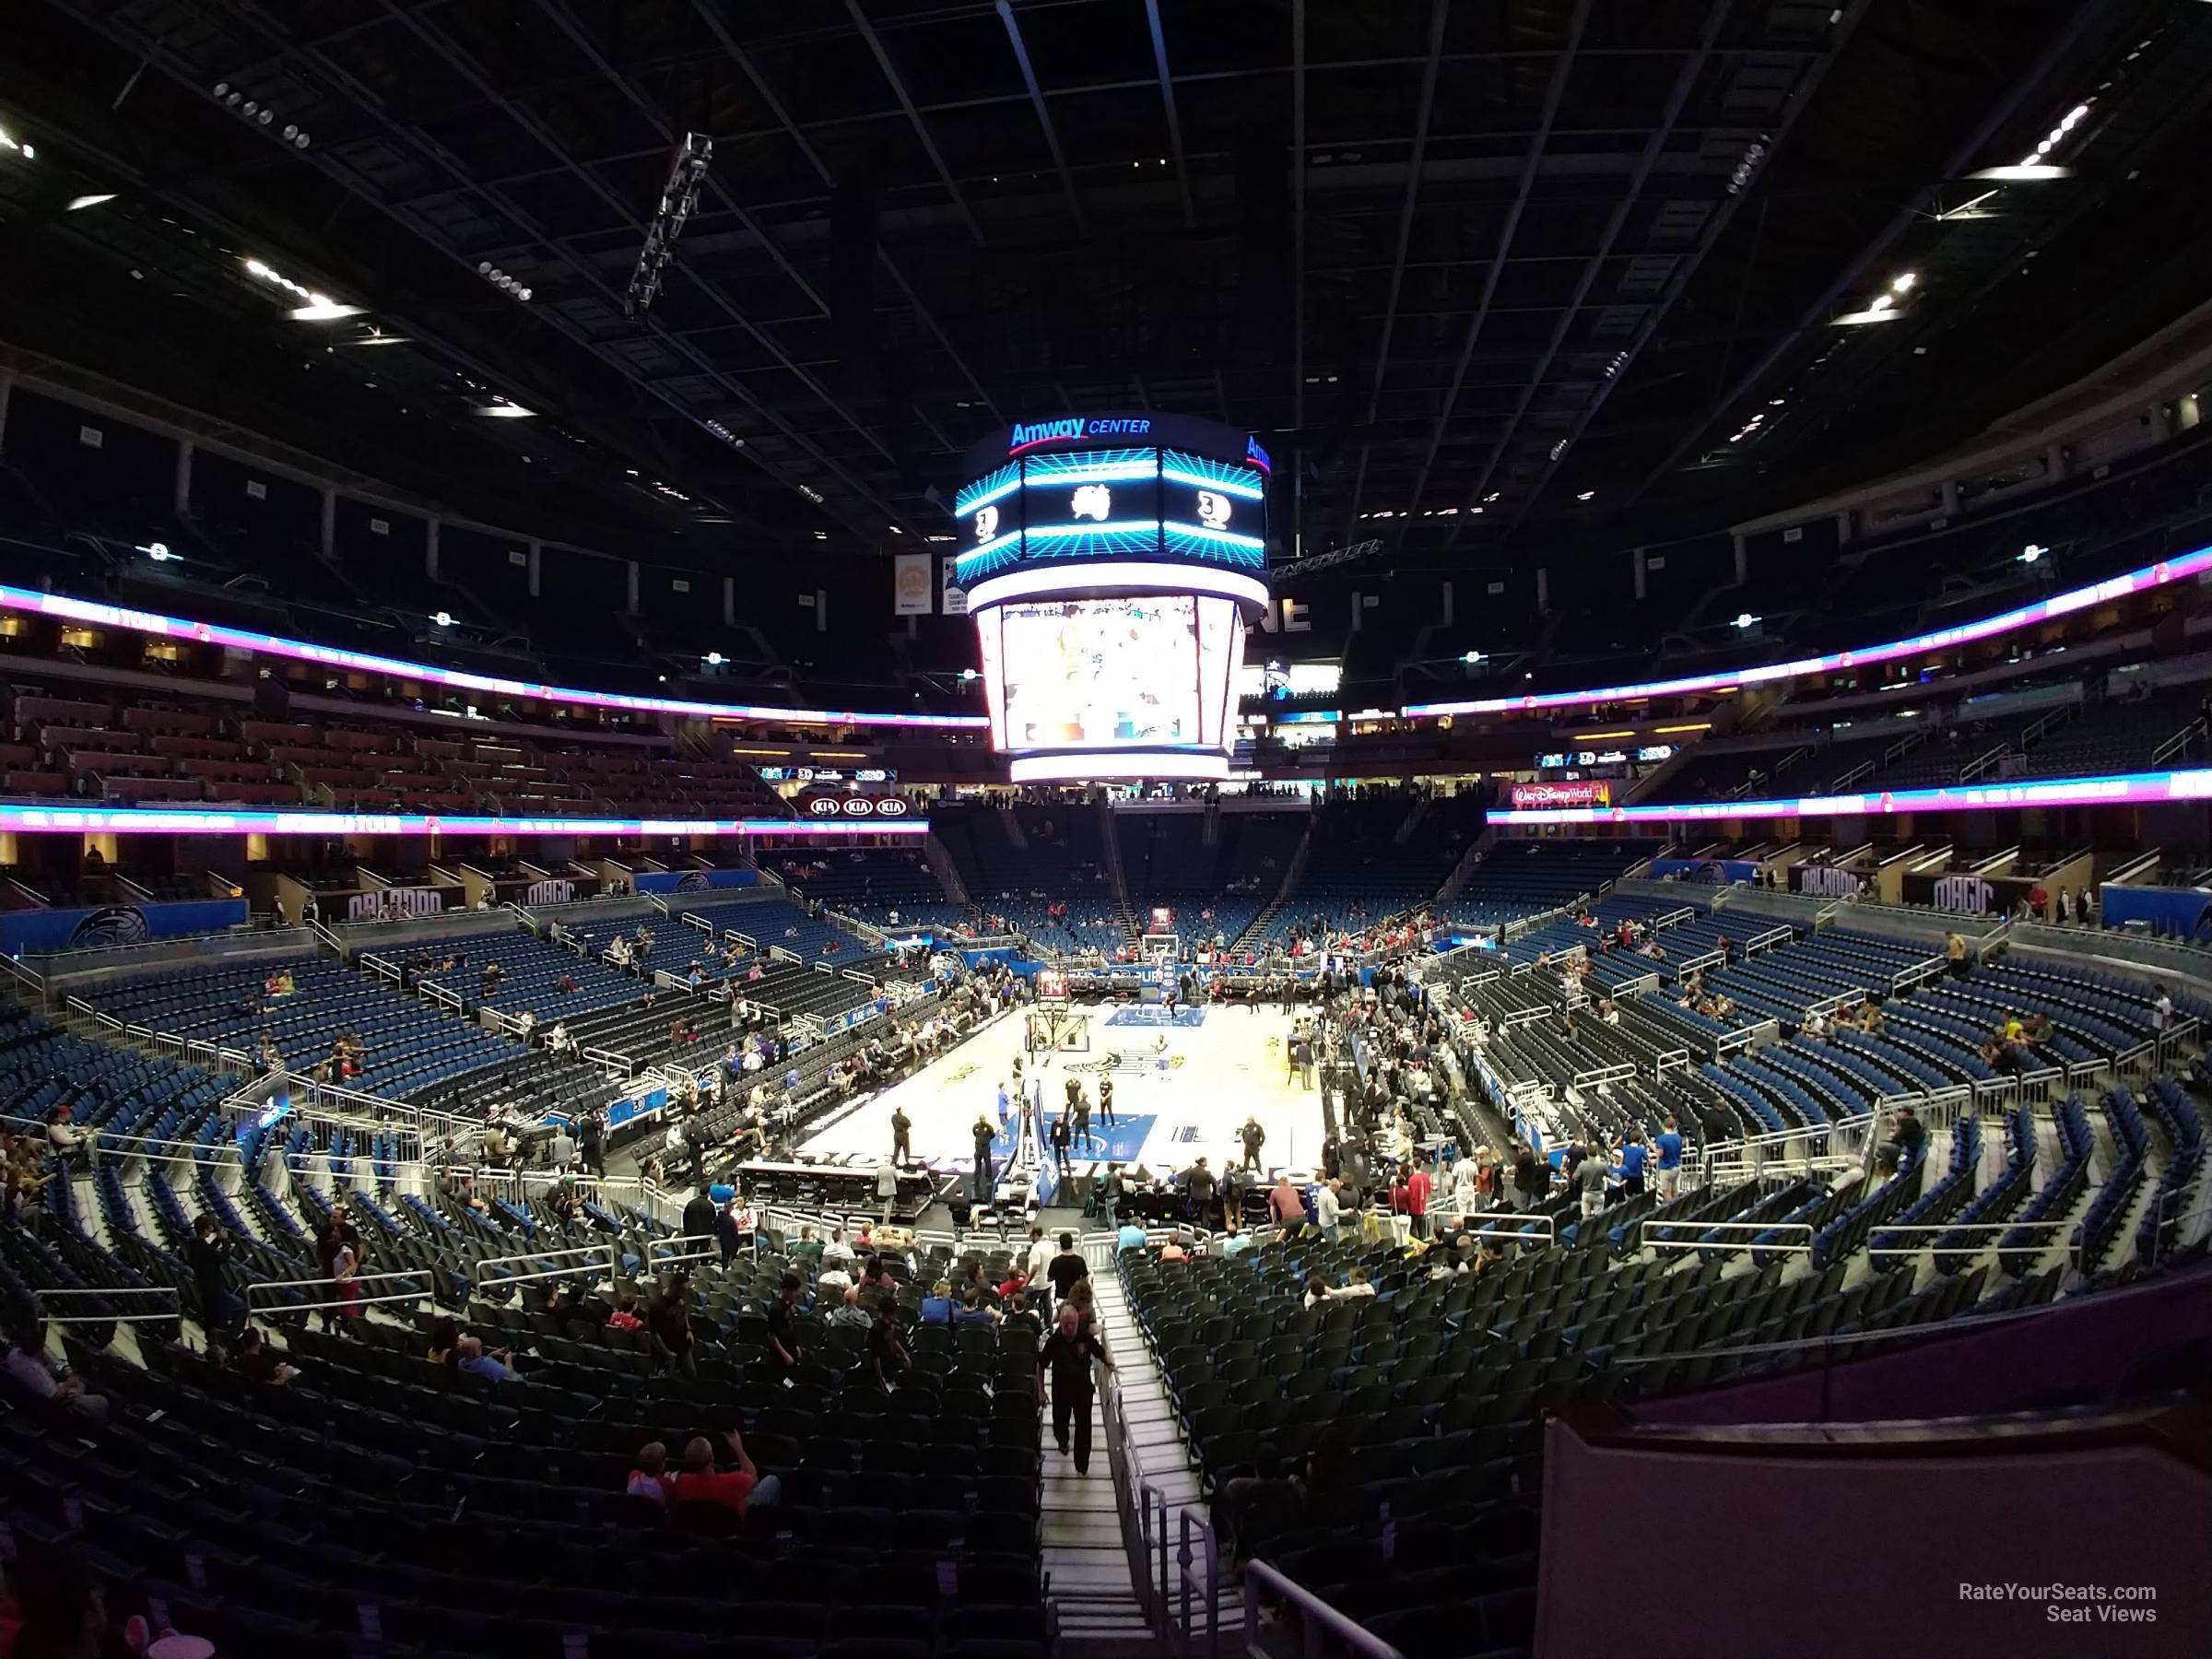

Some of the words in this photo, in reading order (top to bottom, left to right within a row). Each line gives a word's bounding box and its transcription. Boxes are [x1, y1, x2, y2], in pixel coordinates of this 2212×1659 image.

[1011, 418, 1085, 446] Amway
[1089, 419, 1150, 434] CENTER
[1570, 787, 1593, 799] World
[848, 802, 868, 813] KIA
[881, 802, 902, 813] KIA
[527, 879, 575, 905] MAGIC
[1801, 867, 1858, 897] ORLANDO
[348, 888, 442, 920] ORLANDO
[1934, 876, 1994, 917] MAGIC
